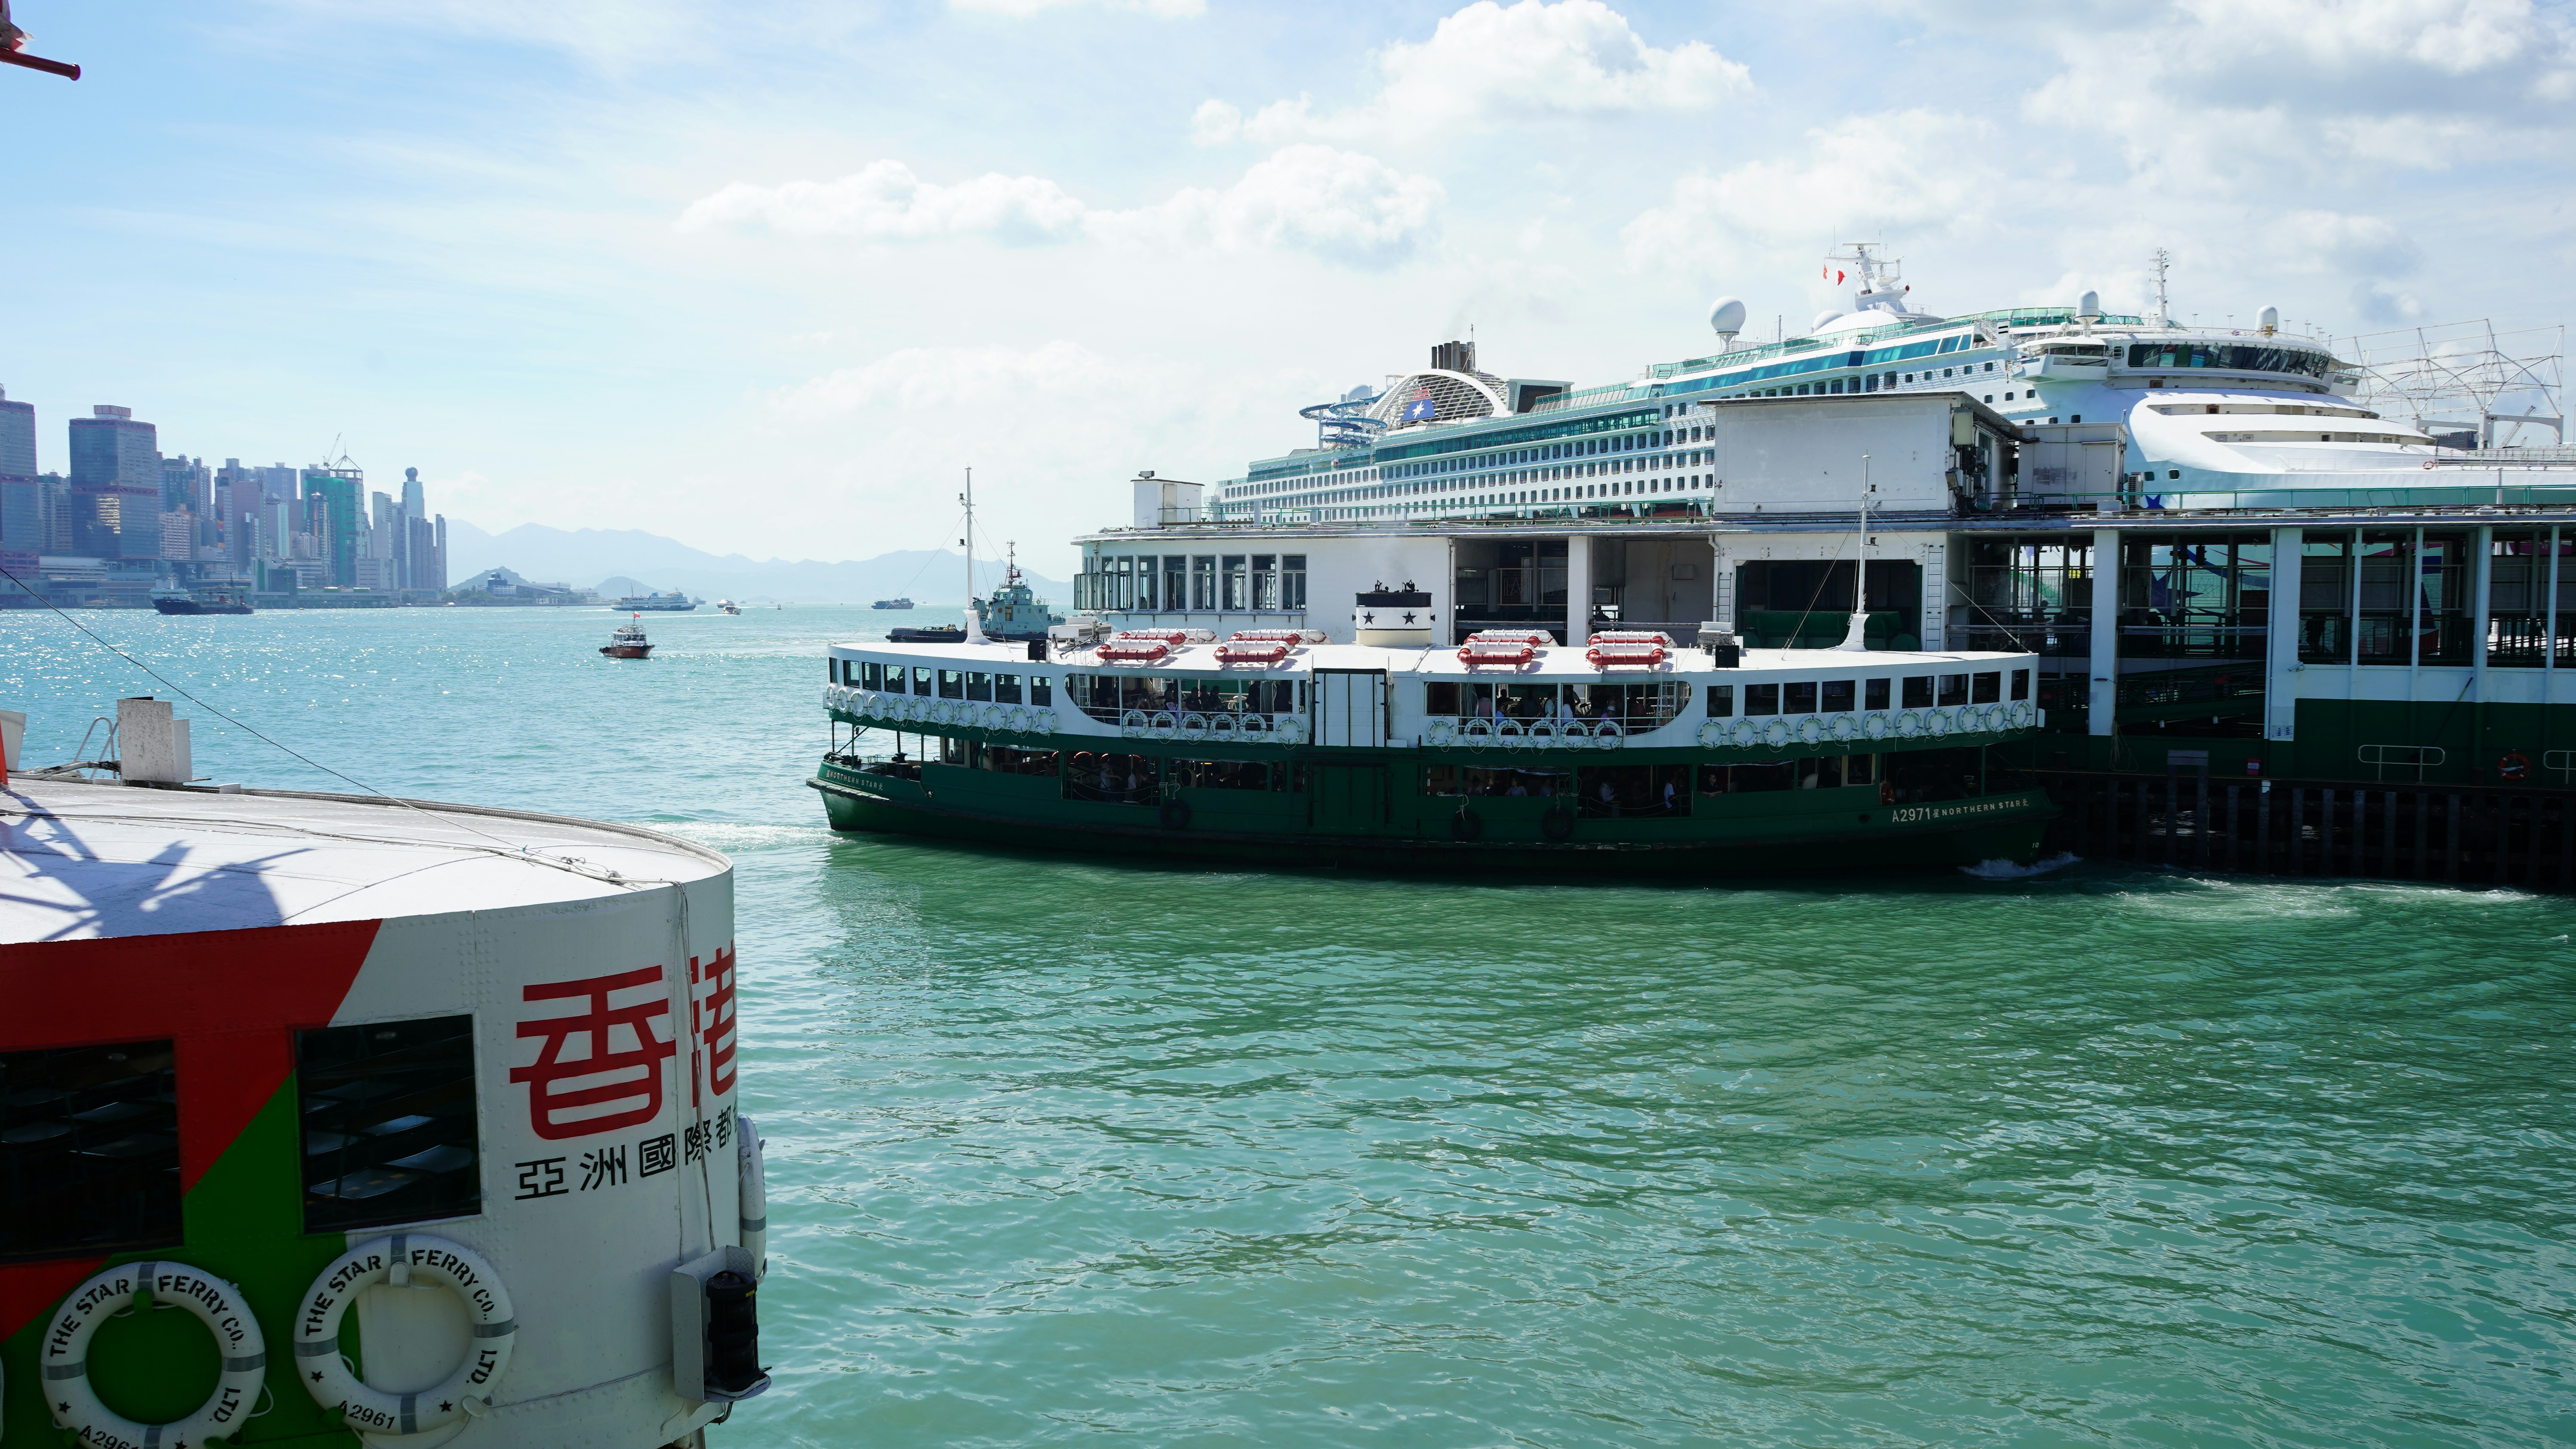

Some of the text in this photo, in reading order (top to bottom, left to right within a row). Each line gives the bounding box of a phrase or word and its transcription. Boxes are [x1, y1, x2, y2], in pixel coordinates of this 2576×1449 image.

[830, 771, 859, 785] NORTHERN
[861, 780, 877, 788] STAR
[1892, 807, 1930, 823] A2971
[1933, 809, 1940, 818] 星
[1941, 803, 1995, 816] NORTHERN
[1999, 800, 2020, 809] STAR
[510, 939, 737, 1140] 香港
[306, 1292, 334, 1336] THE
[329, 1255, 382, 1293] STAR
[411, 1250, 478, 1288] FERRY
[50, 1314, 81, 1357] THE
[76, 1279, 130, 1314] STAR
[158, 1275, 228, 1315] FERRY
[338, 1400, 395, 1429] A2961
[78, 1425, 139, 1449] A296
